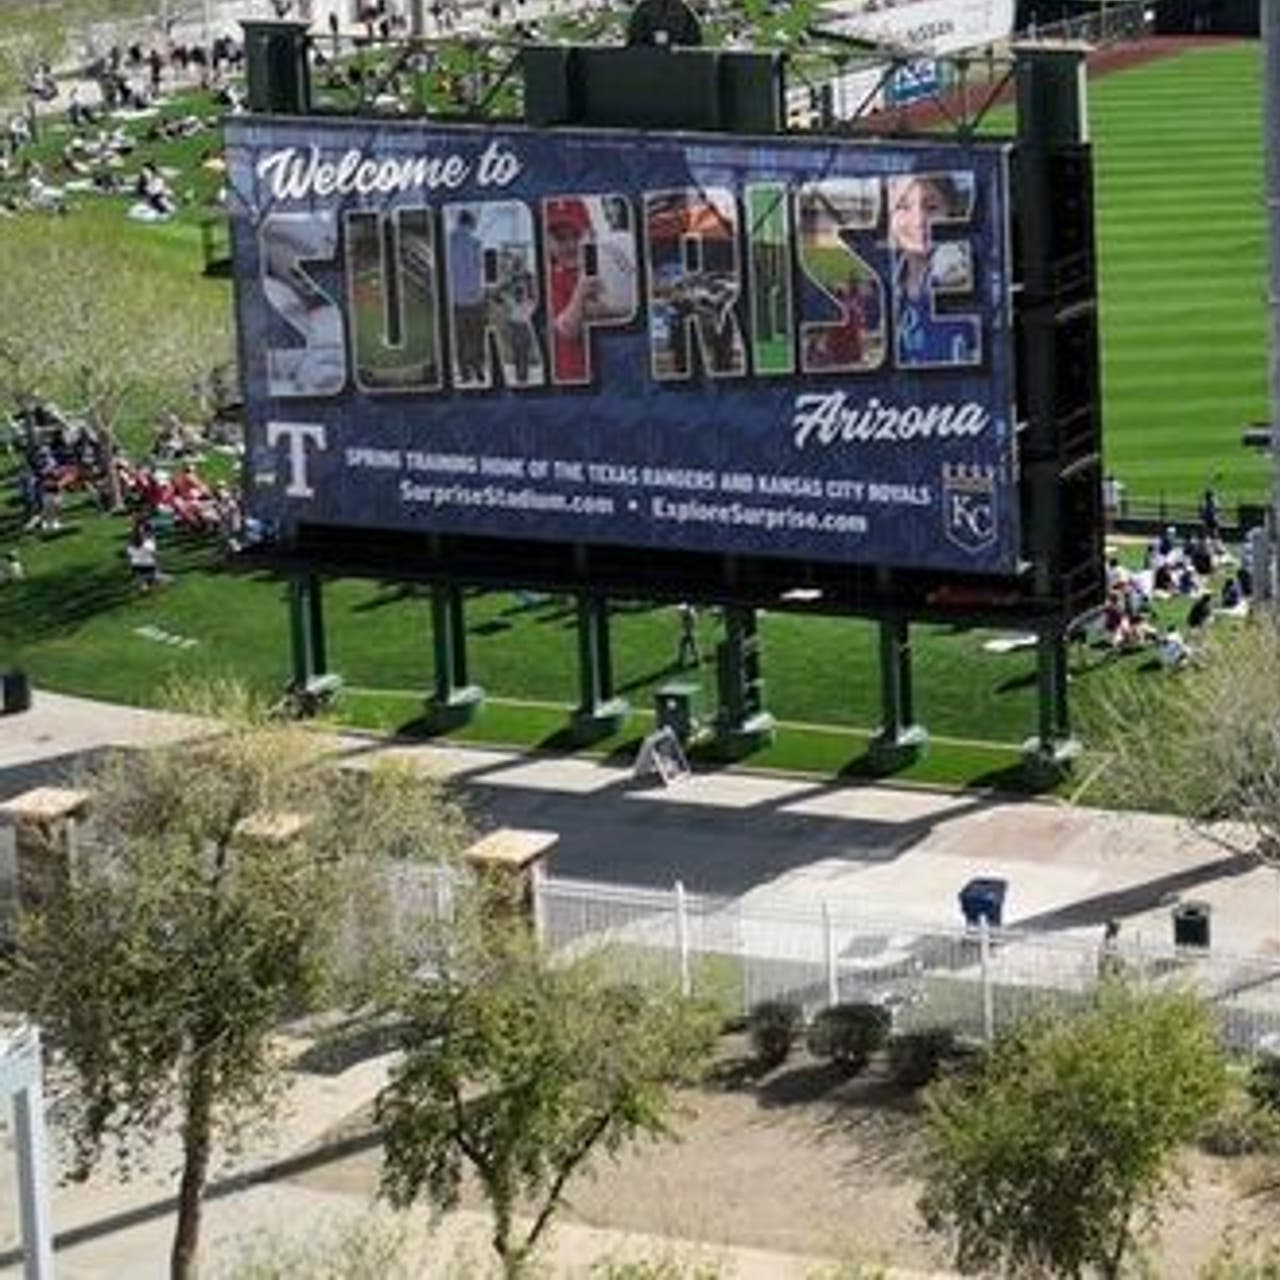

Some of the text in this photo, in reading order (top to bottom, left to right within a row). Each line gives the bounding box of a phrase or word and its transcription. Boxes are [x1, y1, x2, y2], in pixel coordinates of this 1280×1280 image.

[256, 141, 524, 199] Welcome to
[260, 171, 982, 397] SURPRISE
[792, 390, 990, 449] Arizona
[266, 421, 327, 498] T
[345, 448, 932, 506] SPRING TRAINING HOME OF THE TEXAS RANGERS AND KANSAS CITY ROYALS
[400, 479, 868, 534] SurpriseStadium.com ExploreSurprise.com
[951, 493, 992, 538] KC
